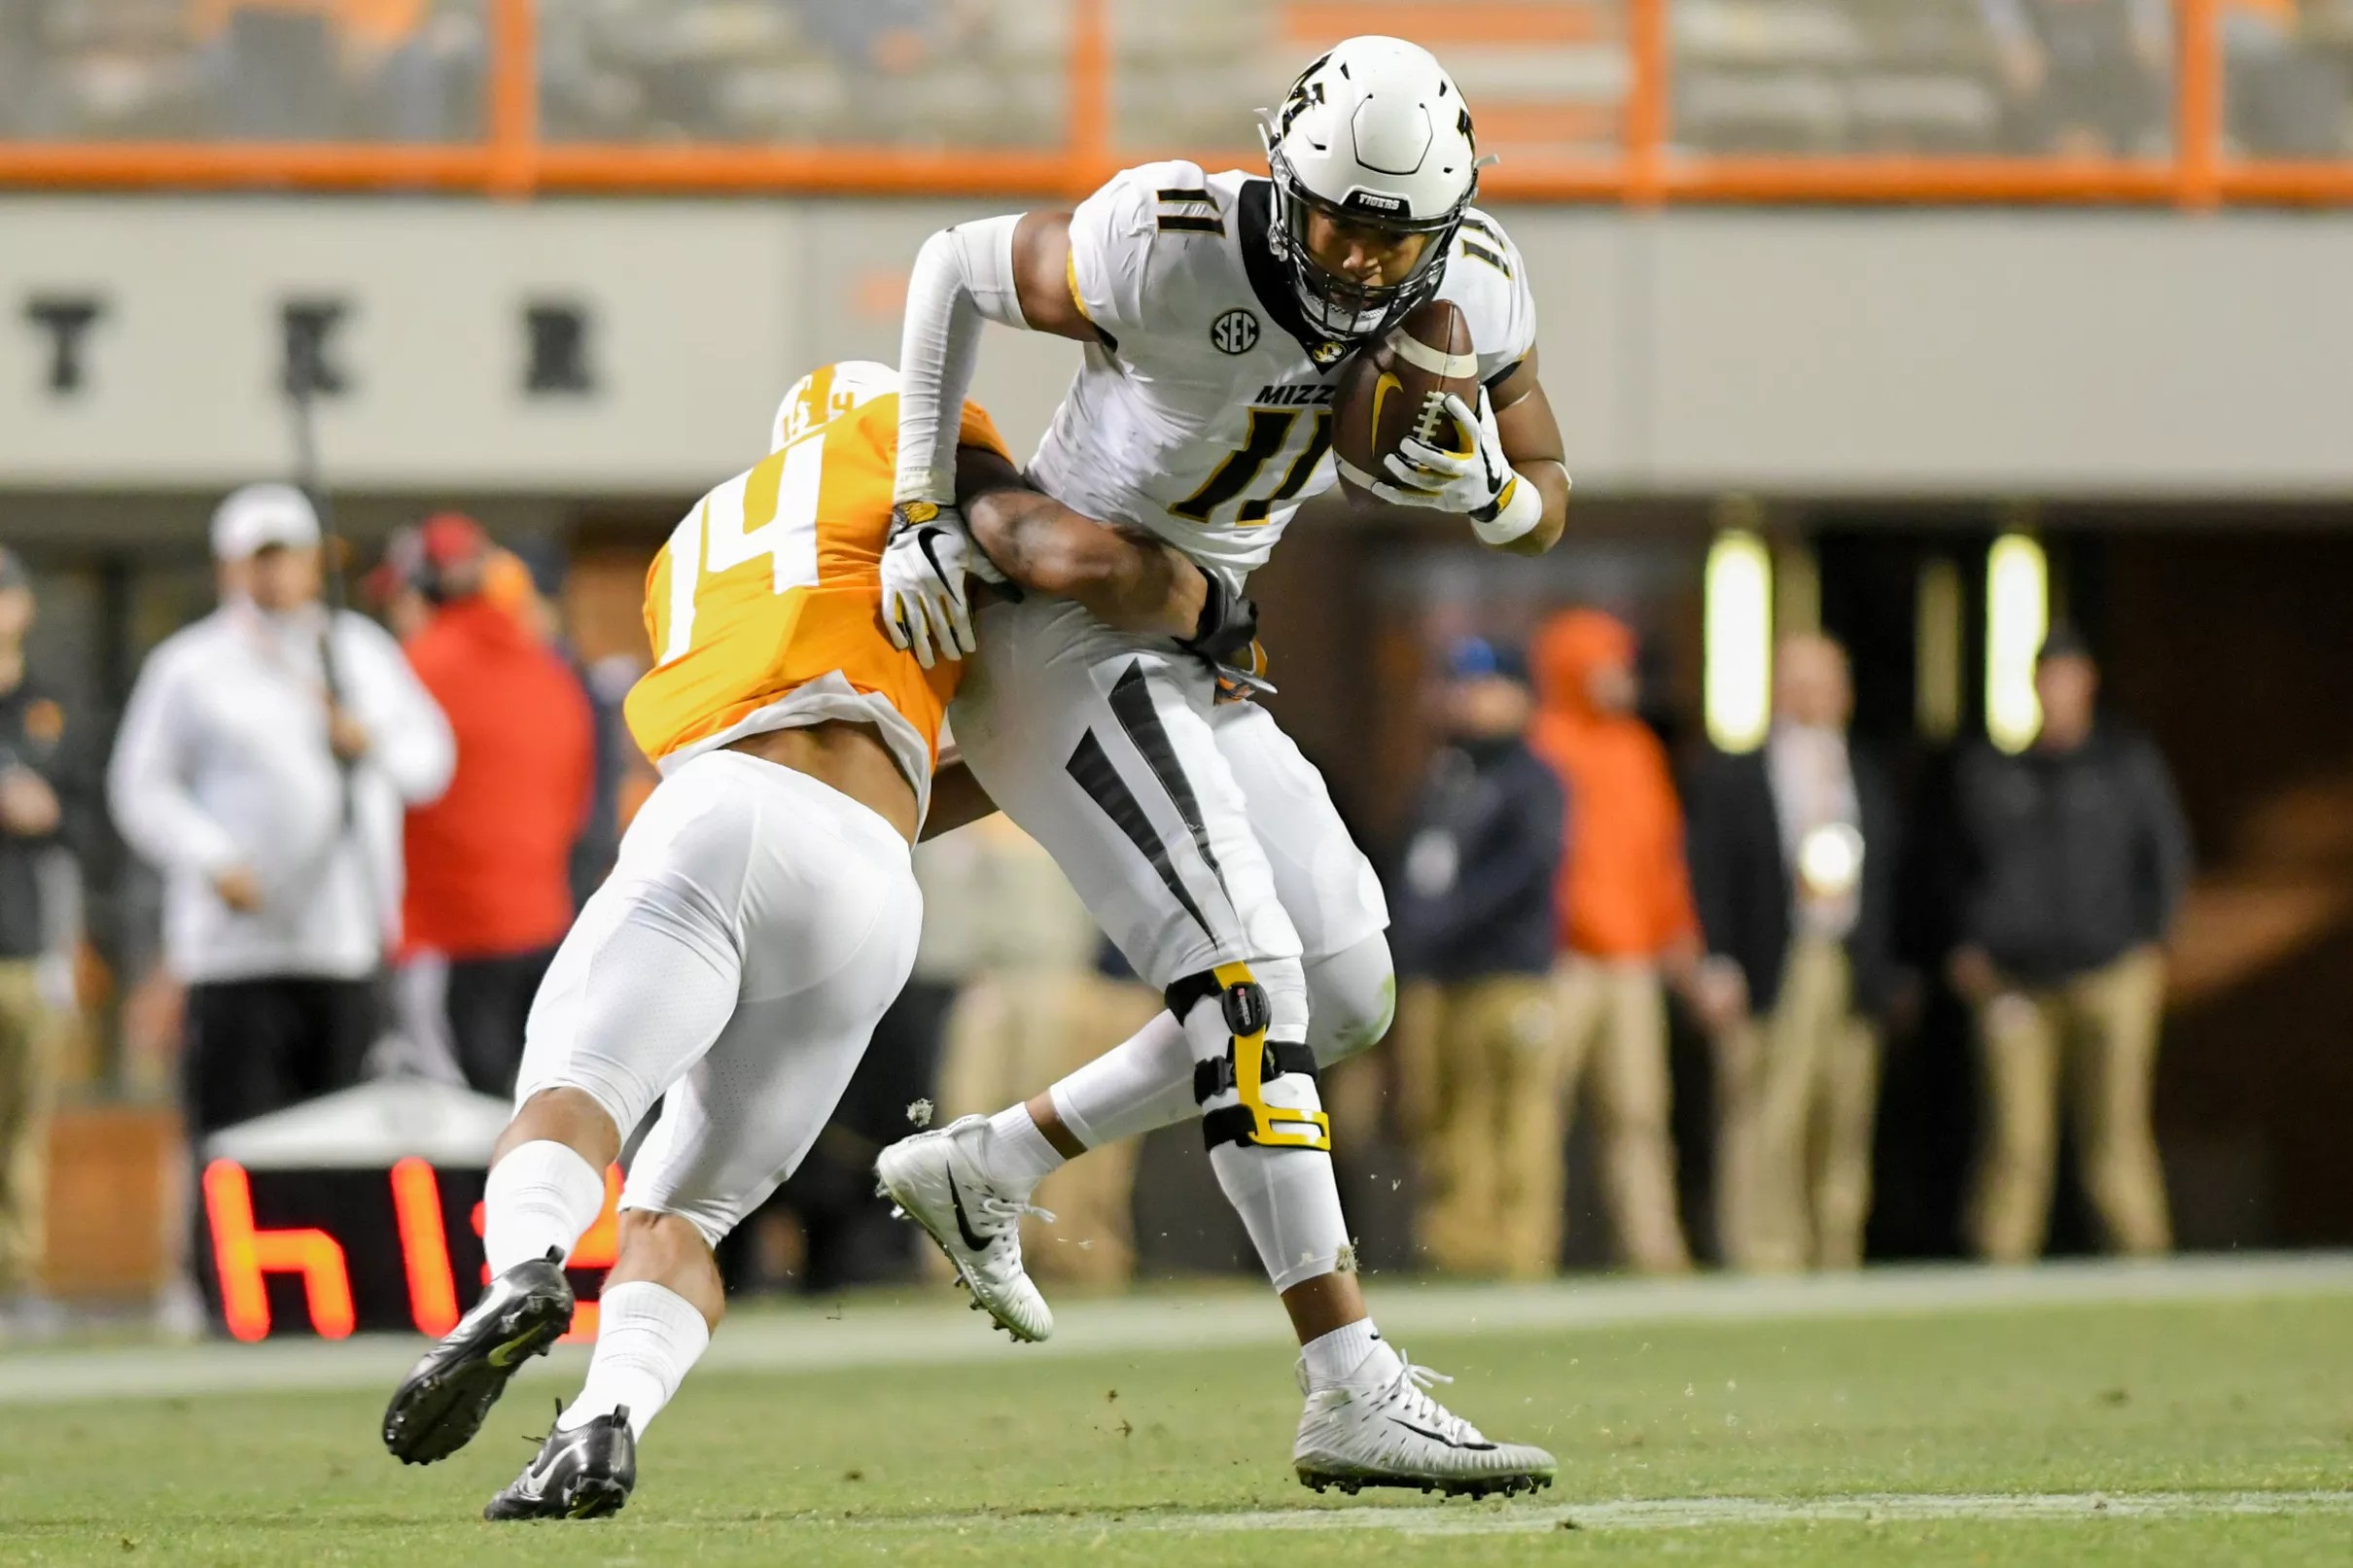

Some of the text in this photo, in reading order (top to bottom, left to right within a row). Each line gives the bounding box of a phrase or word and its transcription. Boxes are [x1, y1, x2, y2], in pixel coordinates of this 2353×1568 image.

[1358, 193, 1400, 210] TIGERS
[1214, 311, 1256, 353] SEC
[1168, 406, 1334, 528] 11
[657, 433, 826, 667] 14
